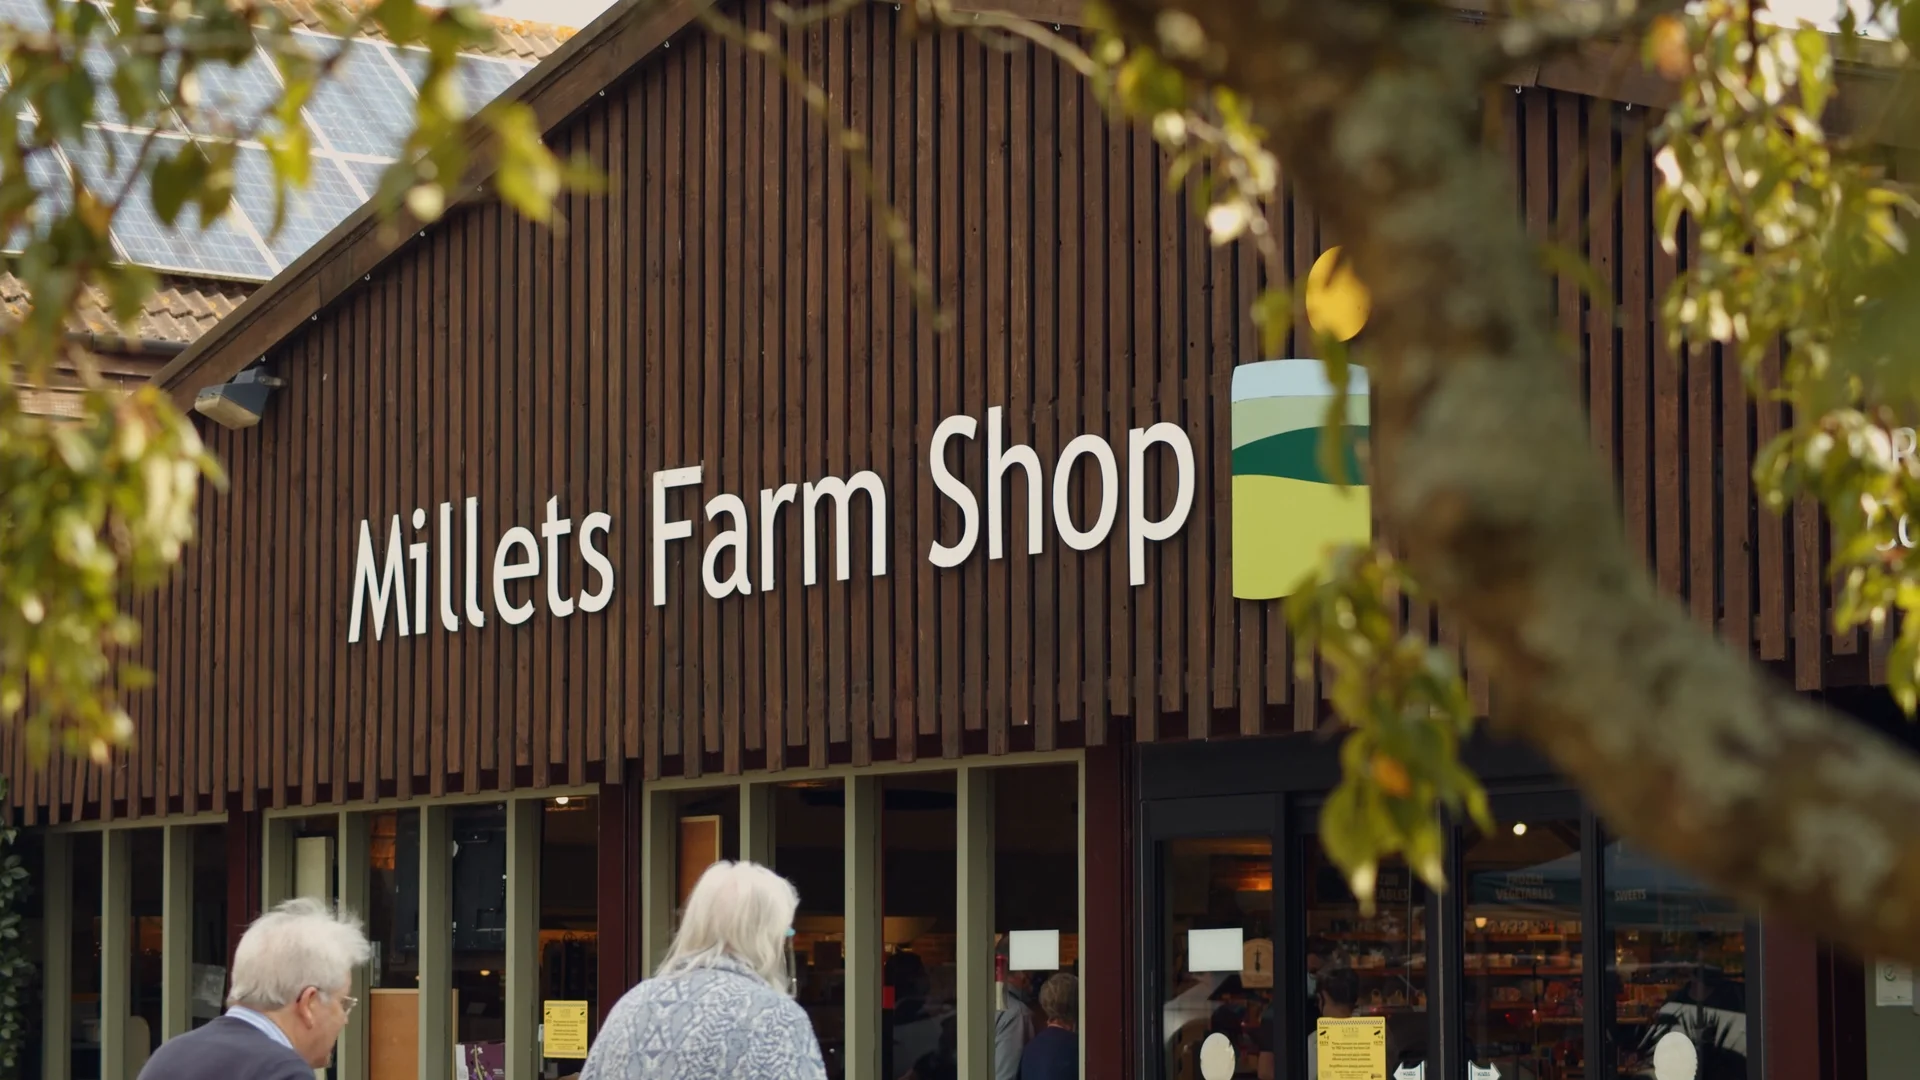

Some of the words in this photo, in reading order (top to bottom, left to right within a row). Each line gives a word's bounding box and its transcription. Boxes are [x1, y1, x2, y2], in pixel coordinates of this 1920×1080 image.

[348, 495, 615, 643] Millets
[653, 465, 887, 606] Farm
[928, 405, 1196, 586] Shop
[1495, 887, 1556, 901] VEGETABLES
[1614, 887, 1647, 902] SWEETS
